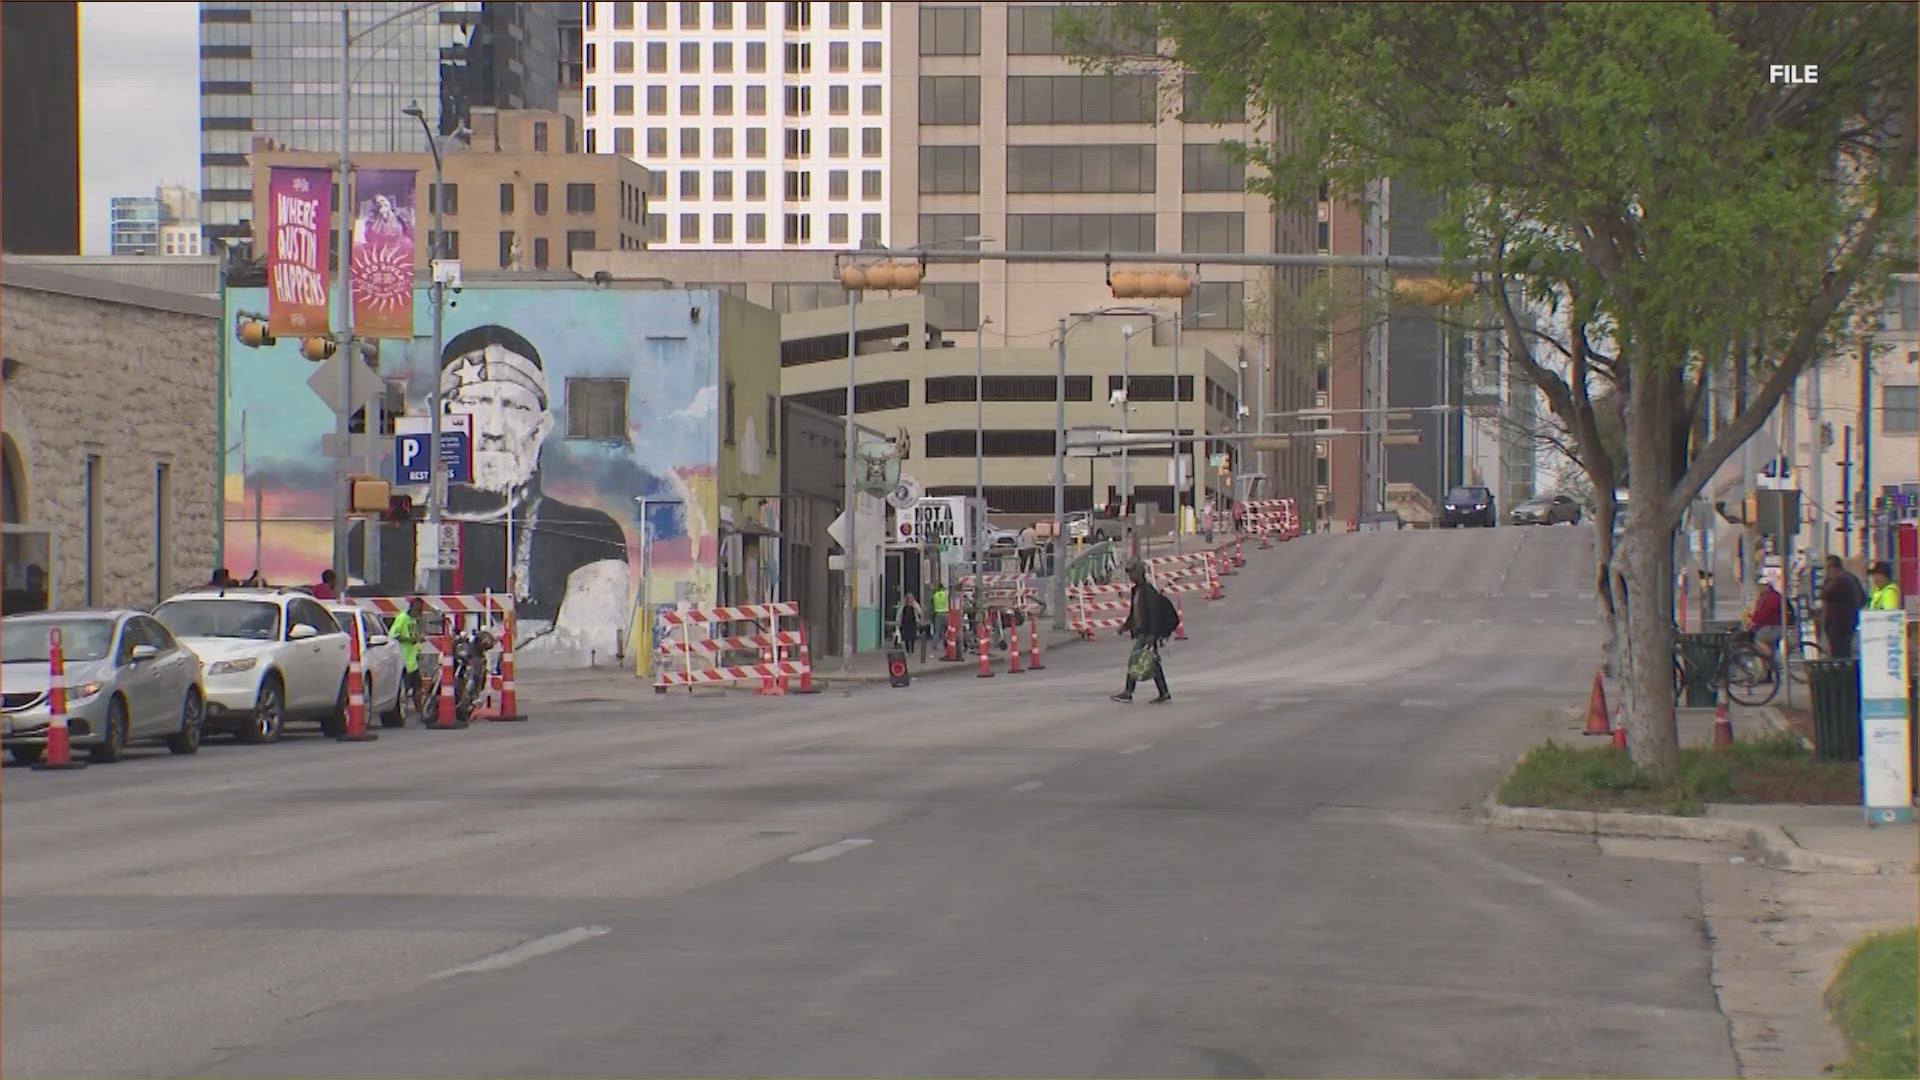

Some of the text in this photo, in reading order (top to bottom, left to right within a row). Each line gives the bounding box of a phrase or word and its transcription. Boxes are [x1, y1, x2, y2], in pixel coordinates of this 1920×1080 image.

[277, 192, 319, 230] WHERE
[274, 263, 326, 307] HAPPENS
[402, 439, 420, 466] P
[409, 471, 429, 480] BEST
[915, 506, 953, 521] NOT A
[915, 521, 954, 537] DAMN
